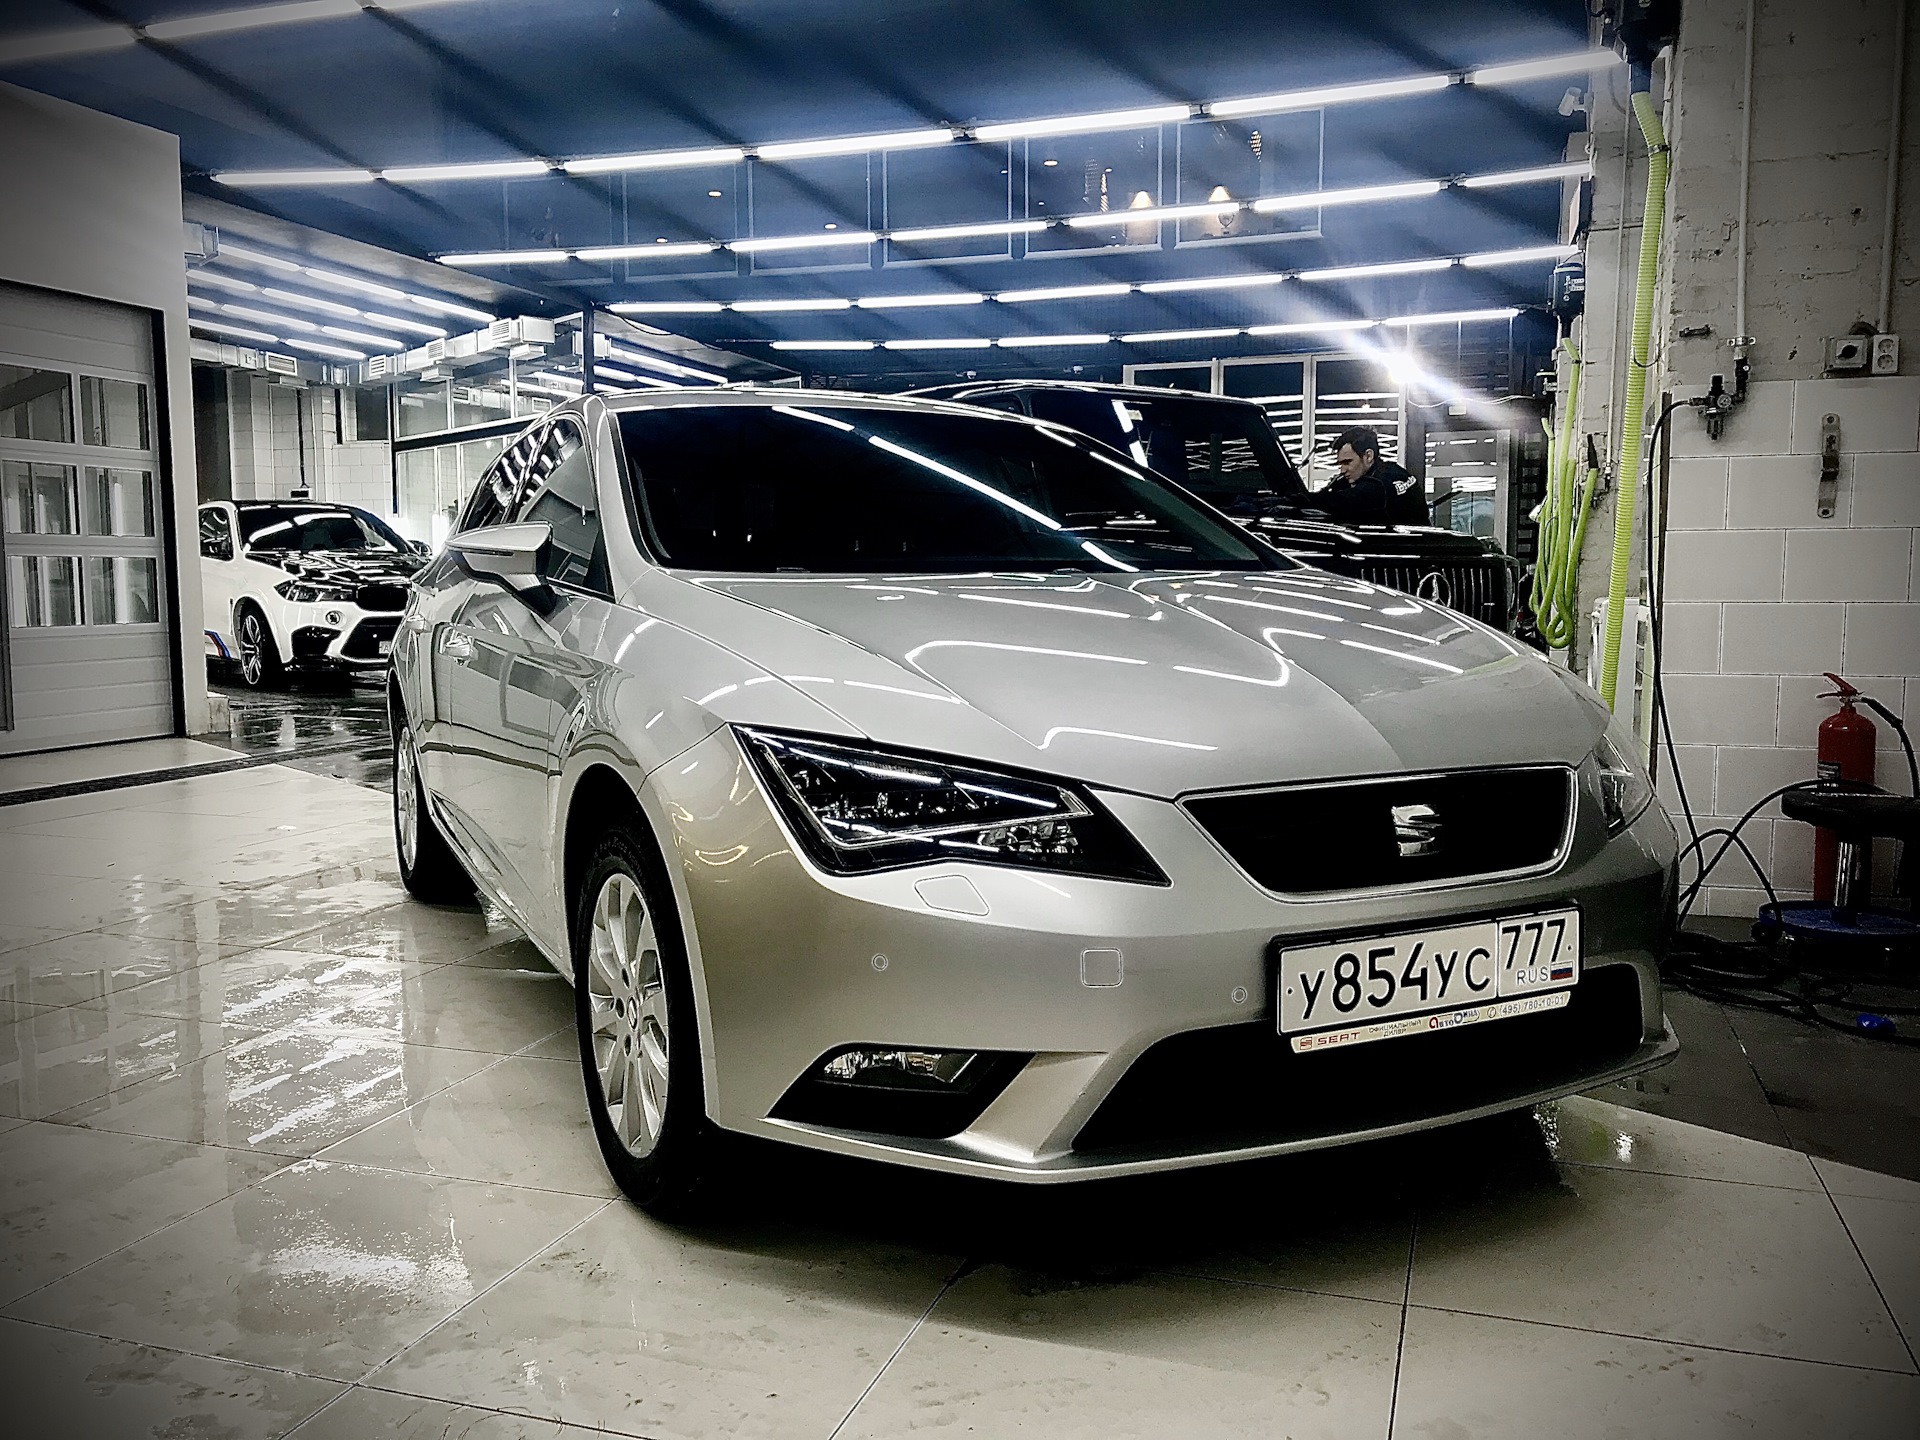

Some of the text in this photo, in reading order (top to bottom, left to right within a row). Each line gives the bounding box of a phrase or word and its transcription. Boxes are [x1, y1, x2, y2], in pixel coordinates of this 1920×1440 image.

[1502, 917, 1567, 970] 777
[1517, 966, 1549, 986] RUS
[1499, 995, 1565, 1017] (495) 780-10-01
[1317, 1032, 1361, 1046] SEAT
